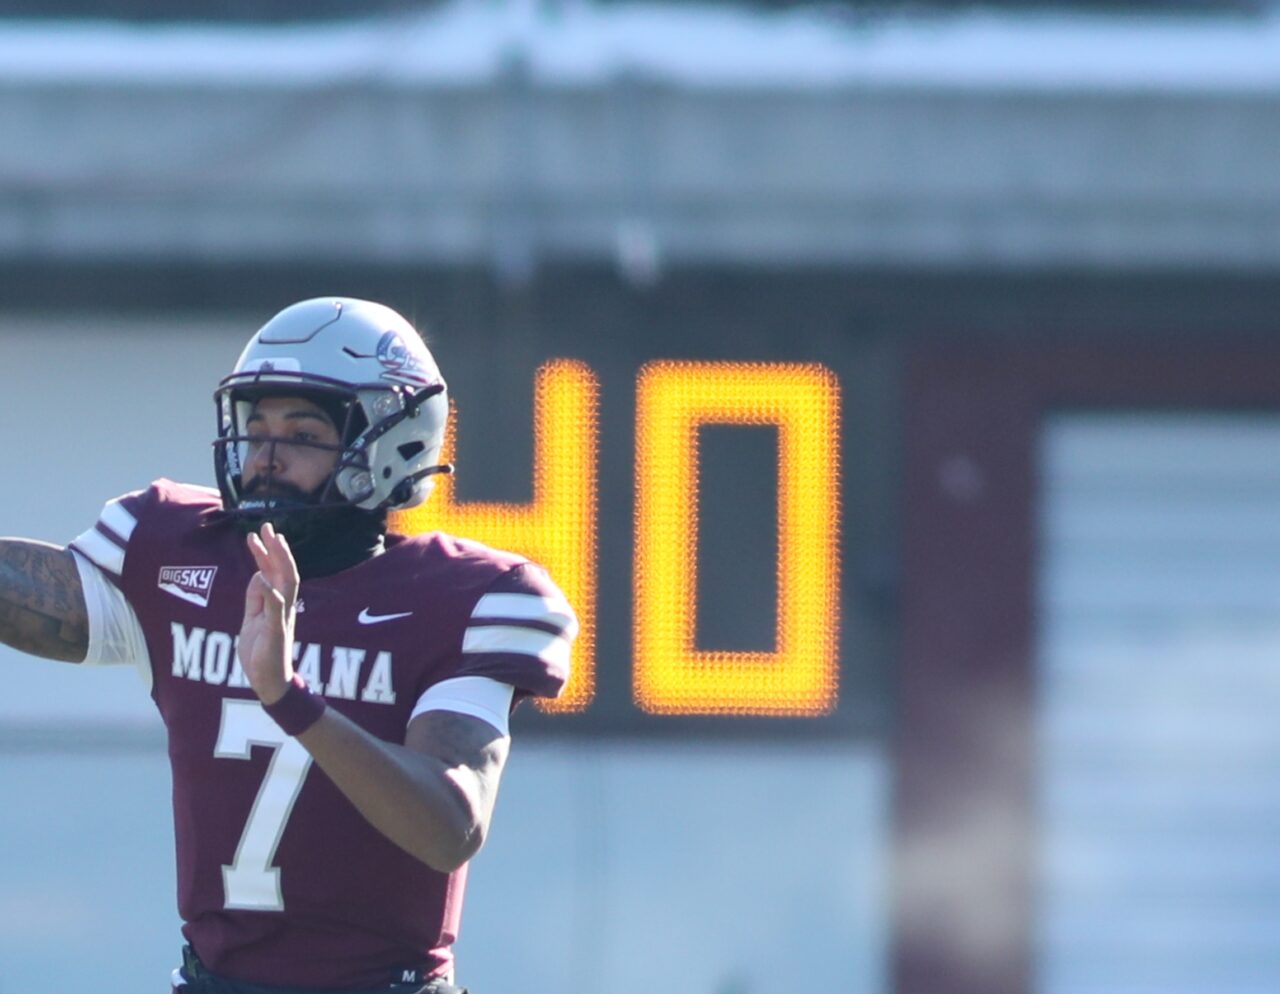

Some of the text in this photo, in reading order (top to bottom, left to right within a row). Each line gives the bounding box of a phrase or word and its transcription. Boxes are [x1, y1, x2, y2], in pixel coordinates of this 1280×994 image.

[387, 357, 842, 717] 40
[170, 621, 396, 704] MOANA
[213, 697, 314, 912] 7
